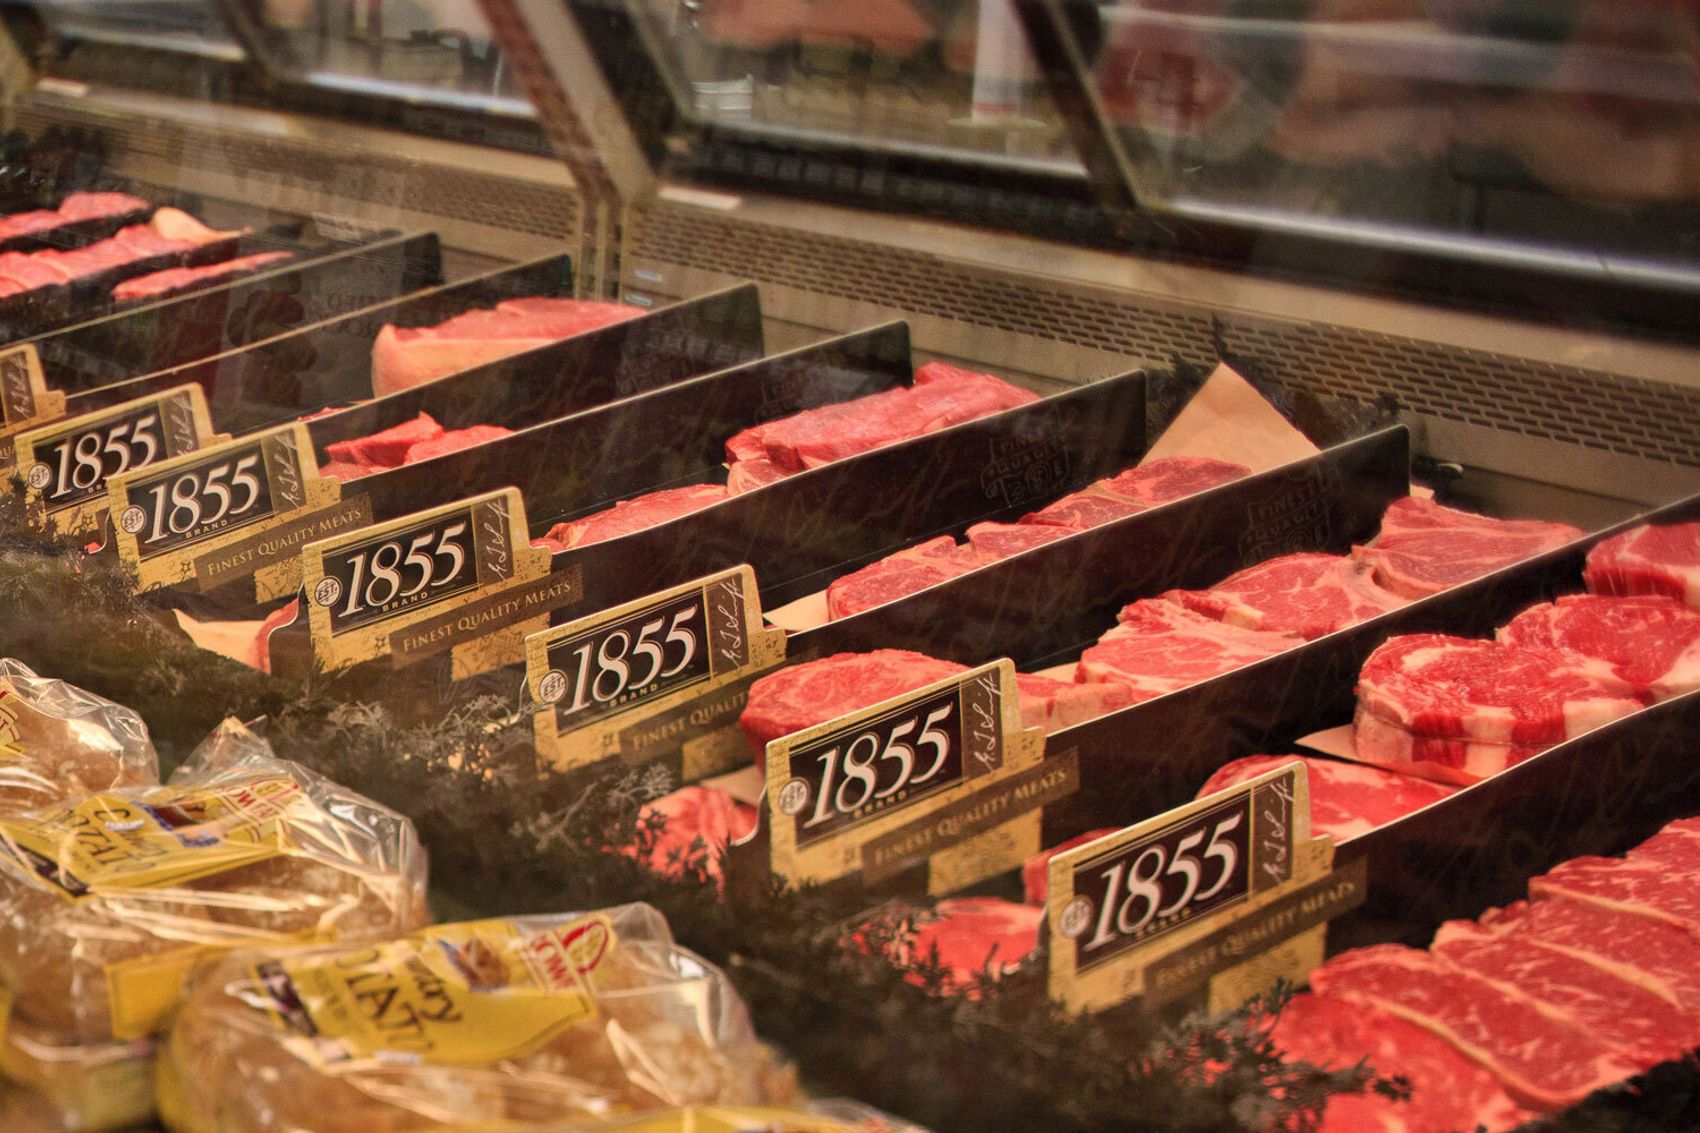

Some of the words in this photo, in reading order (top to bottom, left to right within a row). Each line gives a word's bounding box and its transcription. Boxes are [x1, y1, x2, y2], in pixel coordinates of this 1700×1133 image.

[50, 415, 156, 499] 1855
[144, 454, 259, 544] 1855
[185, 519, 228, 539] BRAND
[208, 550, 254, 576] FINEST
[258, 526, 315, 556] QUALITY
[319, 508, 362, 533] MEATS
[338, 520, 467, 618] 1855
[383, 591, 429, 612] BRAND
[403, 623, 454, 652] FINEST
[457, 600, 520, 632] QUALITY
[525, 581, 571, 606] MEATS
[563, 603, 698, 716] 1855
[609, 683, 658, 708] BRAND
[633, 717, 685, 752] FINEST
[803, 701, 953, 828] 1855
[936, 792, 1010, 838] QUALITY
[1013, 769, 1068, 800] MEATS
[1083, 810, 1244, 952] 1855
